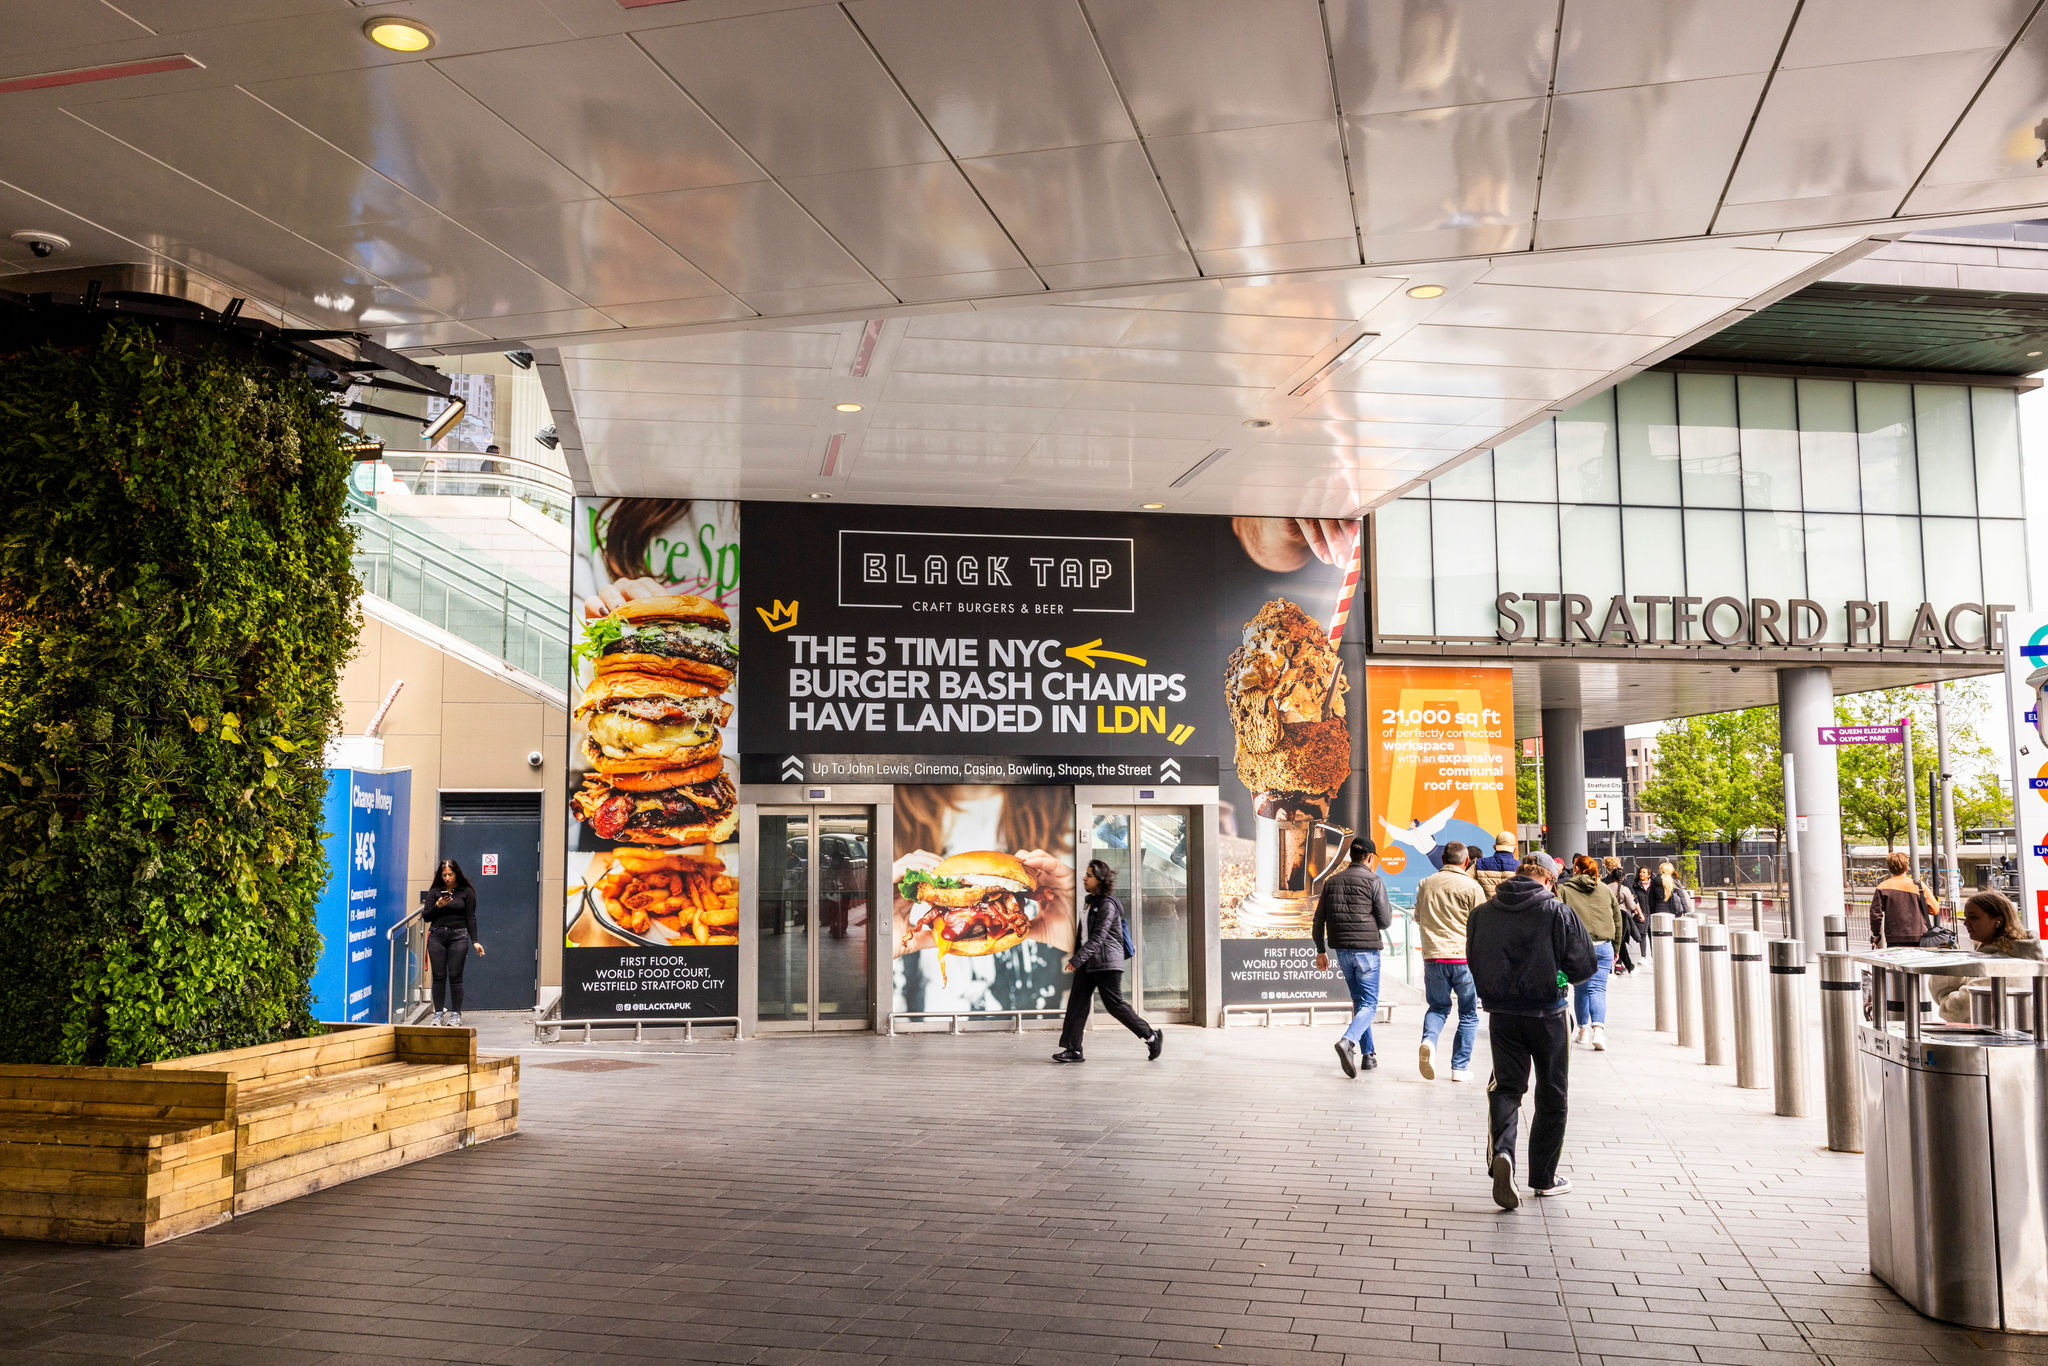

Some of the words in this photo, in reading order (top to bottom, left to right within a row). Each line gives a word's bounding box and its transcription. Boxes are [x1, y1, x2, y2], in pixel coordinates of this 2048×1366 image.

[863, 553, 1012, 586] BLACK
[1030, 557, 1112, 588] TAP
[912, 601, 952, 613] CRAFT
[958, 602, 1015, 614] BURGERS
[1020, 604, 1030, 614] &
[1035, 604, 1064, 615] BEER
[1495, 591, 1828, 646] STRATFORD
[788, 635, 856, 665] THE
[866, 637, 887, 666] 5
[895, 637, 978, 667] TIME
[989, 639, 1062, 668] NYC
[789, 668, 930, 699] BURGER
[940, 670, 1032, 700] BASH
[1041, 672, 1187, 702] CHAMPS
[789, 703, 886, 731] HAVE
[897, 704, 1042, 733] LANDED
[1052, 705, 1087, 733] IN
[1097, 705, 1166, 734] LDN
[1382, 709, 1451, 726] 21,000
[1455, 712, 1479, 727] sq
[1481, 708, 1500, 724] ft
[1382, 728, 1395, 738] of
[1396, 728, 1444, 740] perfectly
[1446, 728, 1502, 738] connected
[1383, 740, 1455, 754] workspace
[1398, 754, 1421, 764] with
[1423, 755, 1436, 764] an
[1437, 753, 1503, 767] expansive
[812, 762, 829, 777] Up
[831, 762, 845, 775] To
[847, 762, 874, 775] John
[876, 763, 912, 777] Lewis,
[914, 764, 962, 777] Cinema,
[965, 764, 1006, 777] Casino,
[1008, 764, 1056, 778] Bowling,
[1058, 764, 1095, 778] Shops,
[1097, 764, 1115, 776] the
[1118, 764, 1152, 776] Street
[1438, 766, 1504, 777] communal
[1424, 780, 1453, 791] roof
[1455, 780, 1504, 791] terrace
[353, 785, 375, 814] Change
[375, 788, 393, 816] Money
[1264, 948, 1288, 958] FIRST
[620, 956, 646, 967] FIRST
[650, 955, 687, 967] FLOOR,
[1243, 960, 1278, 969] WORLD
[1280, 960, 1308, 969] FOOD
[596, 969, 635, 979] WORLD
[638, 968, 670, 979] FOOD
[673, 967, 711, 979] COURT,
[1231, 971, 1280, 981] WESTFIELD
[1283, 970, 1334, 980] STRATFORD
[582, 981, 638, 992] WESTFIELD
[641, 980, 699, 991] STRATFORD
[702, 979, 725, 990] CITY
[1276, 991, 1328, 1000] @BLACKTAPUK
[632, 1002, 691, 1012] @BLACKTAPUK
